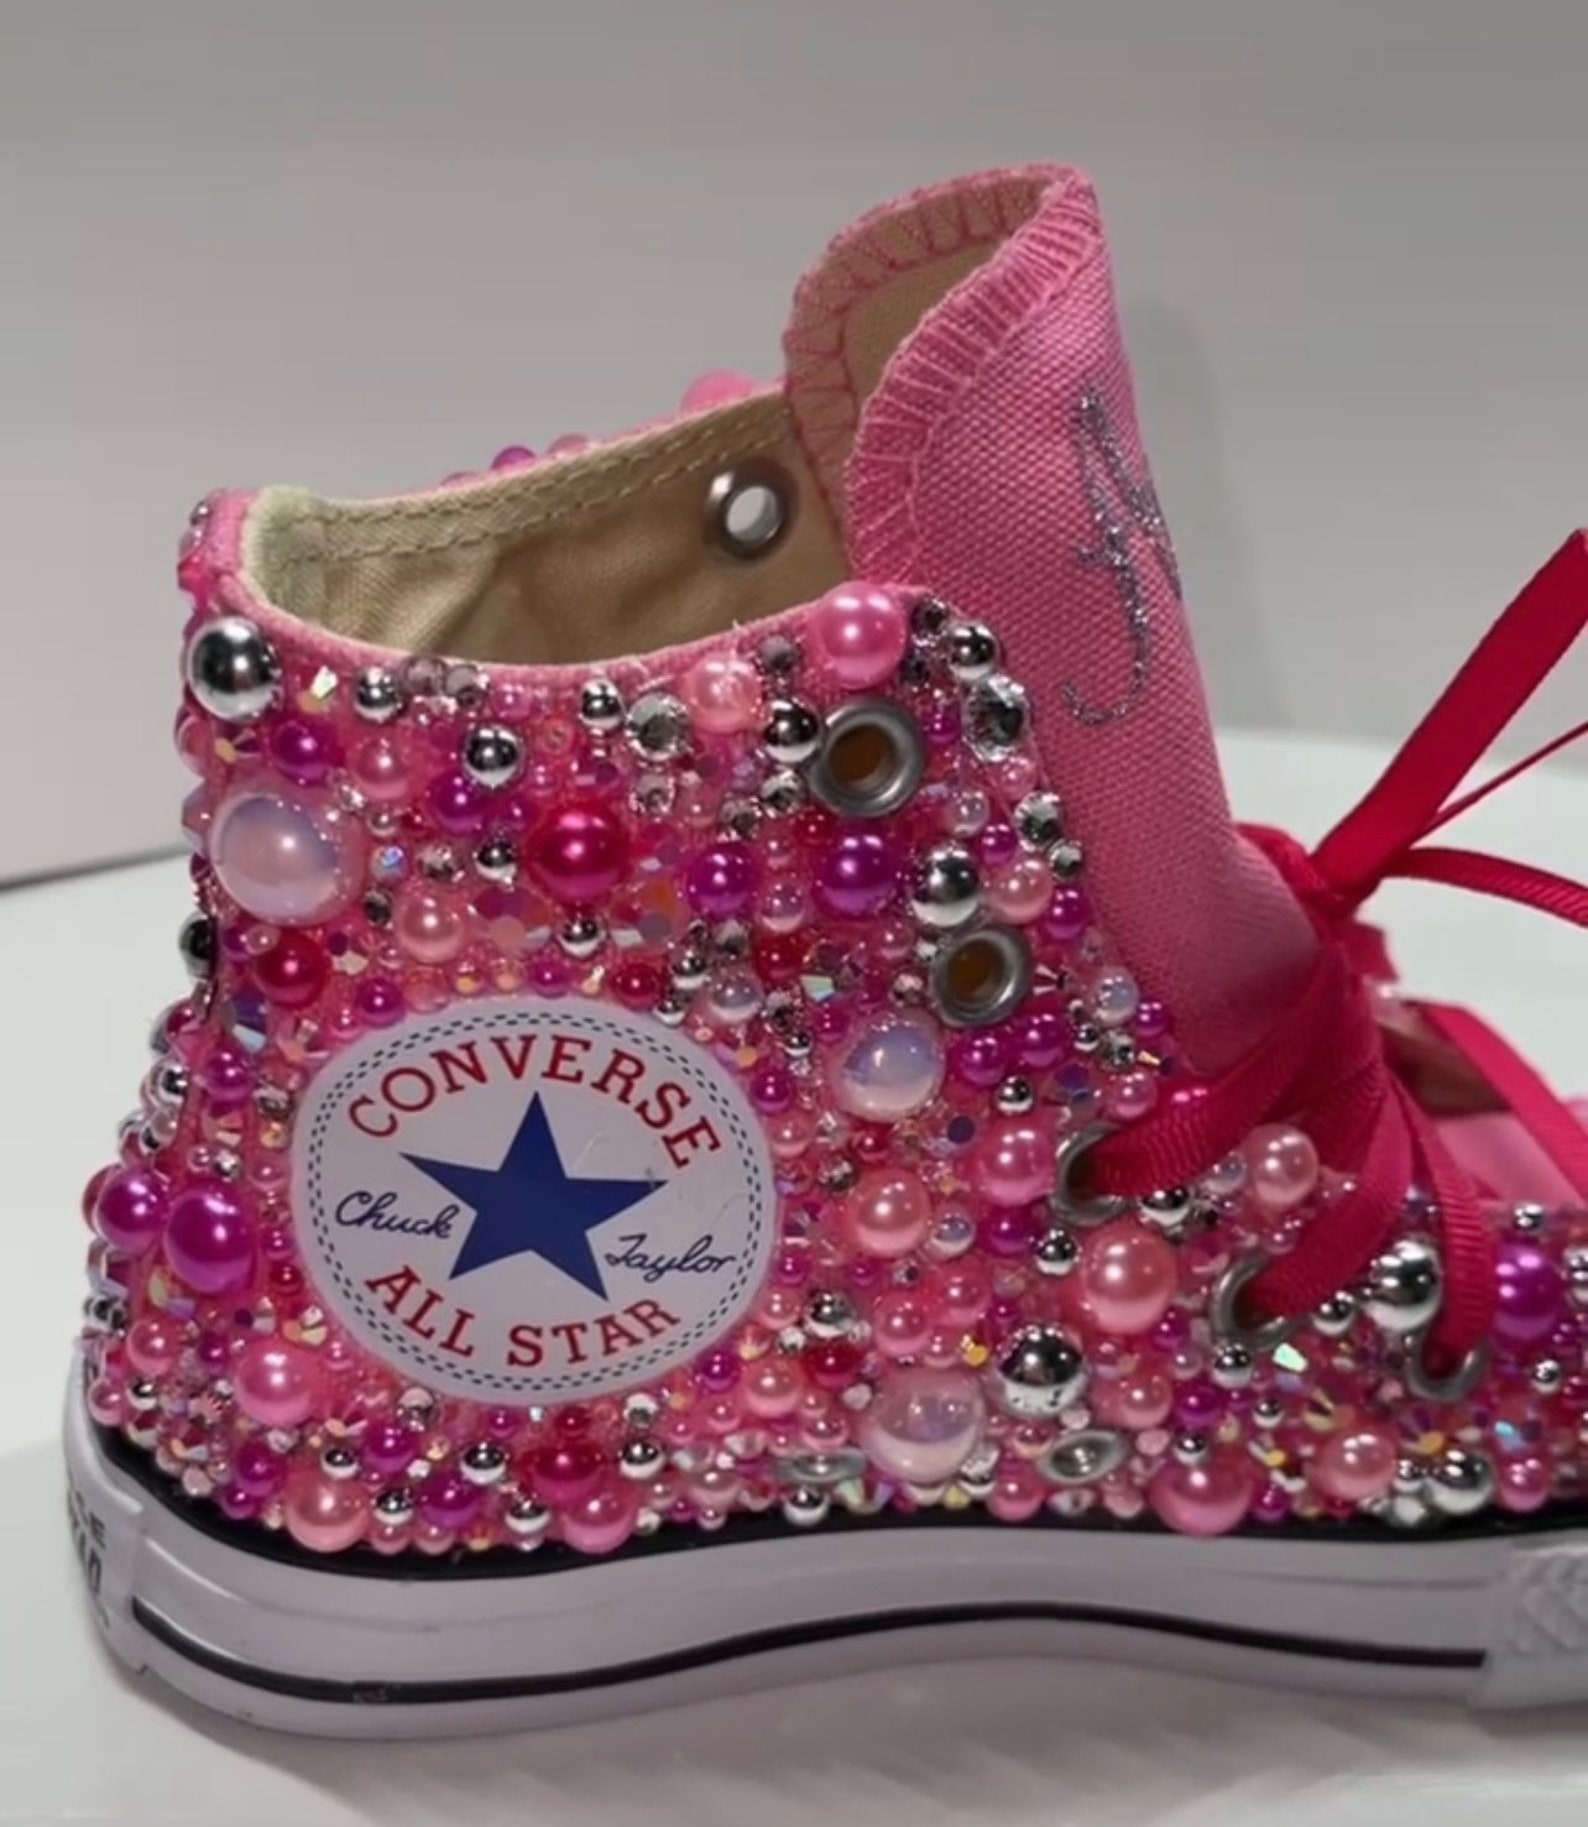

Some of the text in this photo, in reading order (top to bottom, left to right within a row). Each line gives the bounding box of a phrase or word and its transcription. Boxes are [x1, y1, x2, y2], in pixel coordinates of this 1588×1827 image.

[348, 1034, 721, 1169] CONVERSE
[335, 1191, 737, 1282] Chuck Taylor
[365, 1265, 682, 1368] ALL STAR
